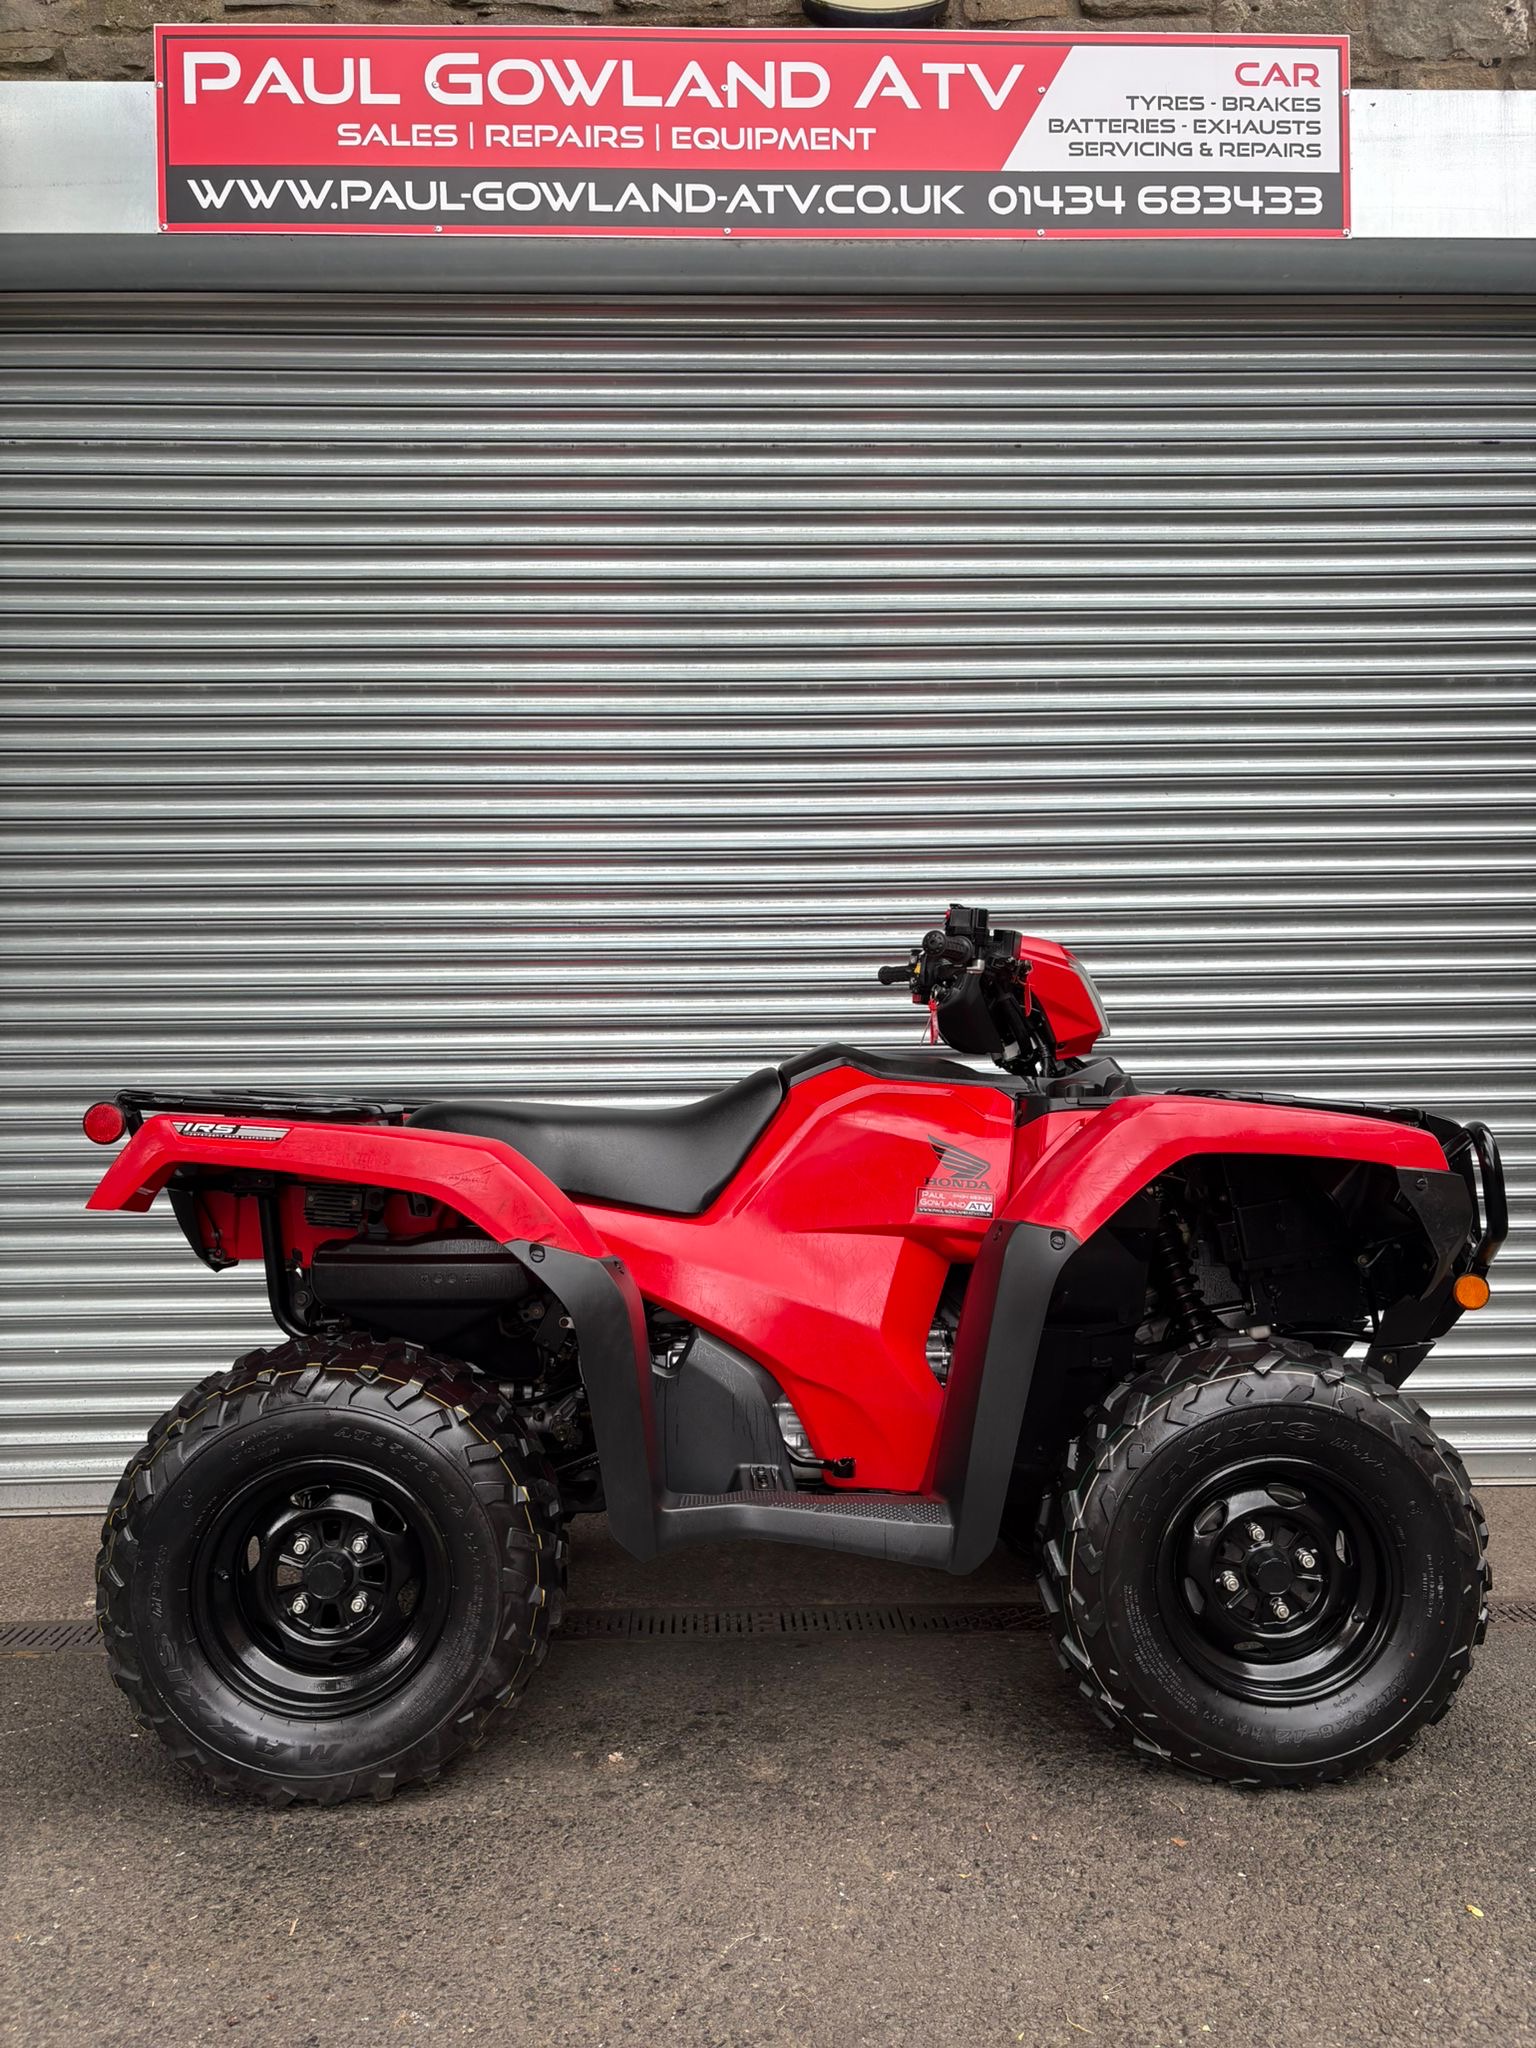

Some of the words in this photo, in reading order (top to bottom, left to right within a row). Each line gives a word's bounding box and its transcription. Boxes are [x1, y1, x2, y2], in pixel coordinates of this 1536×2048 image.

[183, 51, 401, 105] PAUL
[424, 52, 831, 109] GOWLAND
[853, 55, 1025, 111] ATV
[1234, 62, 1320, 87] CAR
[1125, 95, 1205, 111] TYRES
[1222, 96, 1321, 113] BRAKES
[1048, 118, 1176, 134] BATTERIES
[1193, 119, 1322, 136] EXHAUSTS
[337, 123, 459, 147] SALES
[485, 124, 645, 149] REPAIRS
[671, 126, 877, 151] EQUIPMENT
[1068, 141, 1193, 157] SERVICING
[1199, 142, 1214, 157] &
[1219, 142, 1322, 158] REPAIRS
[186, 179, 965, 215] WWW.PAUL-GOWLAND-ATV.CO.UK
[987, 184, 1126, 216] 01434
[1137, 185, 1324, 216] 683433
[184, 1122, 237, 1135] IRS
[924, 1177, 991, 1191] HONDA
[921, 1190, 946, 1200] PAUL
[919, 1198, 967, 1209] GOWLAND
[968, 1202, 992, 1211] ATV
[156, 1632, 345, 1763] MAXXIS
